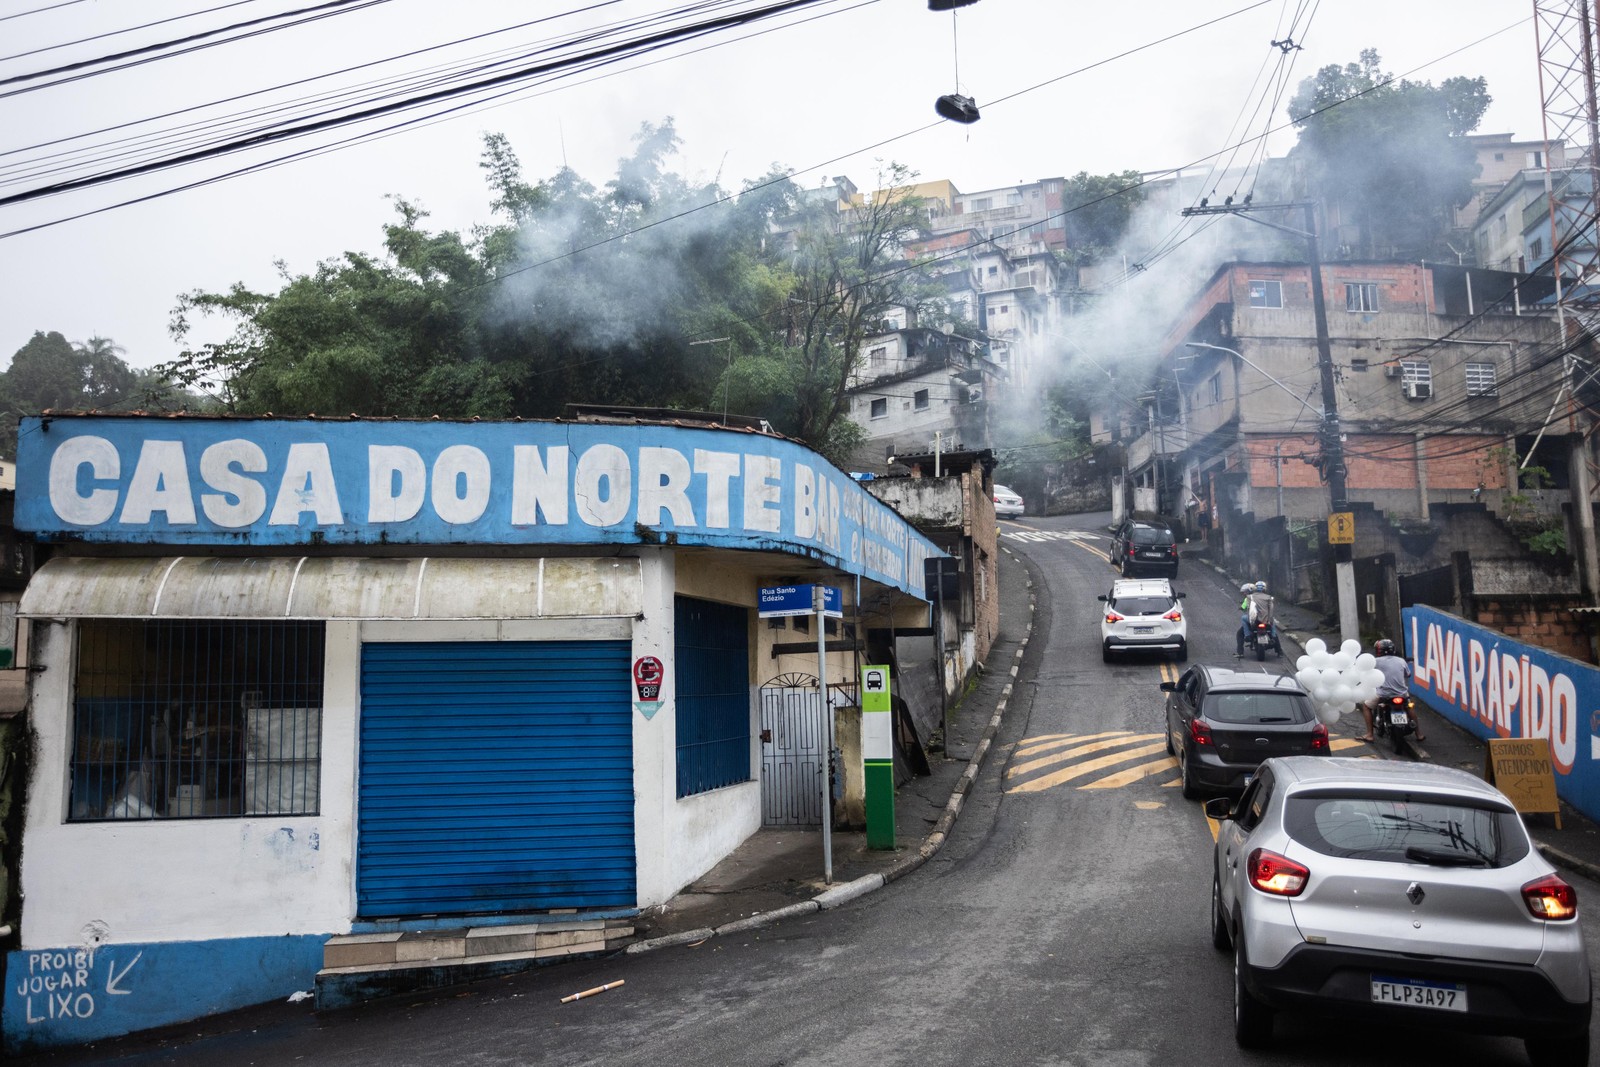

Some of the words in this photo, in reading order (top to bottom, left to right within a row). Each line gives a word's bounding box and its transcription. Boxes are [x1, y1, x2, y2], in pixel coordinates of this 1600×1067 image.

[49, 435, 344, 528] CASA
[368, 444, 490, 524] DO
[511, 444, 781, 533] NORTE
[795, 463, 841, 553] BAR
[881, 511, 904, 550] NORTE
[762, 588, 775, 596] Rua
[776, 587, 796, 595] Santo
[1411, 616, 1468, 711] LAVA
[1492, 744, 1535, 756] ESTAMOS
[1496, 759, 1550, 775] ATENDENDO
[29, 951, 94, 975] PROIBI
[18, 970, 88, 996] JOGAR
[1381, 984, 1456, 1007] FLP3A97
[27, 992, 94, 1024] LIXO
